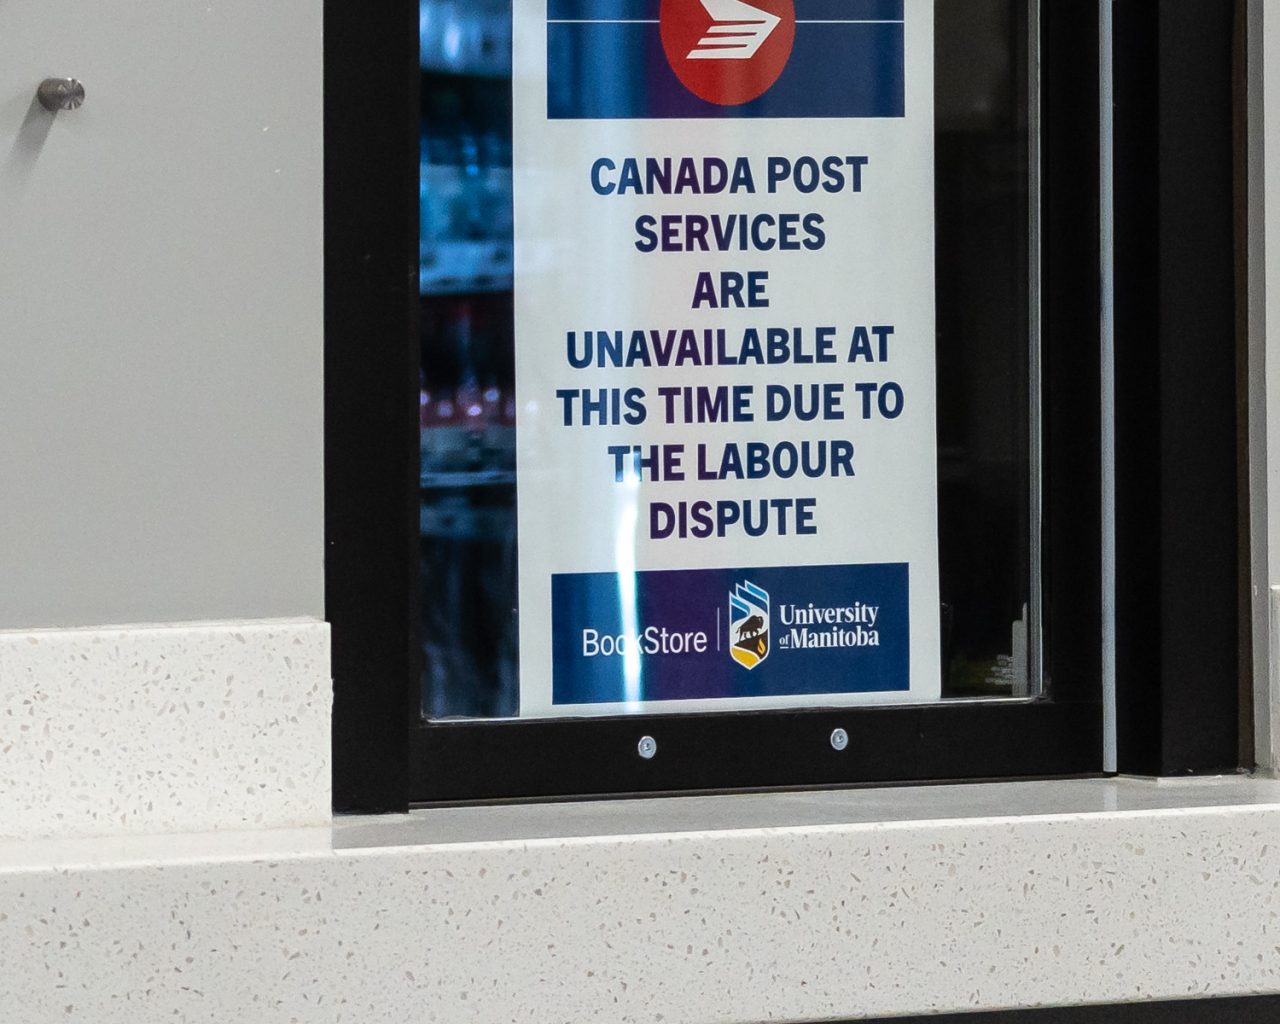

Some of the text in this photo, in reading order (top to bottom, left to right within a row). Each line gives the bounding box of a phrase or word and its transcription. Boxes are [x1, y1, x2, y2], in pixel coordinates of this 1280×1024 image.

[591, 156, 868, 195] CANADA POST
[635, 213, 825, 252] SERVICES
[692, 271, 769, 308] ARE
[567, 326, 894, 368] UNAVAILABLE AT
[556, 382, 904, 426] THIS TIME DUE TO
[608, 440, 855, 481] THE LABOUR
[650, 498, 817, 539] DISPUTE
[780, 602, 879, 627] University
[779, 626, 879, 649] of Manitoba
